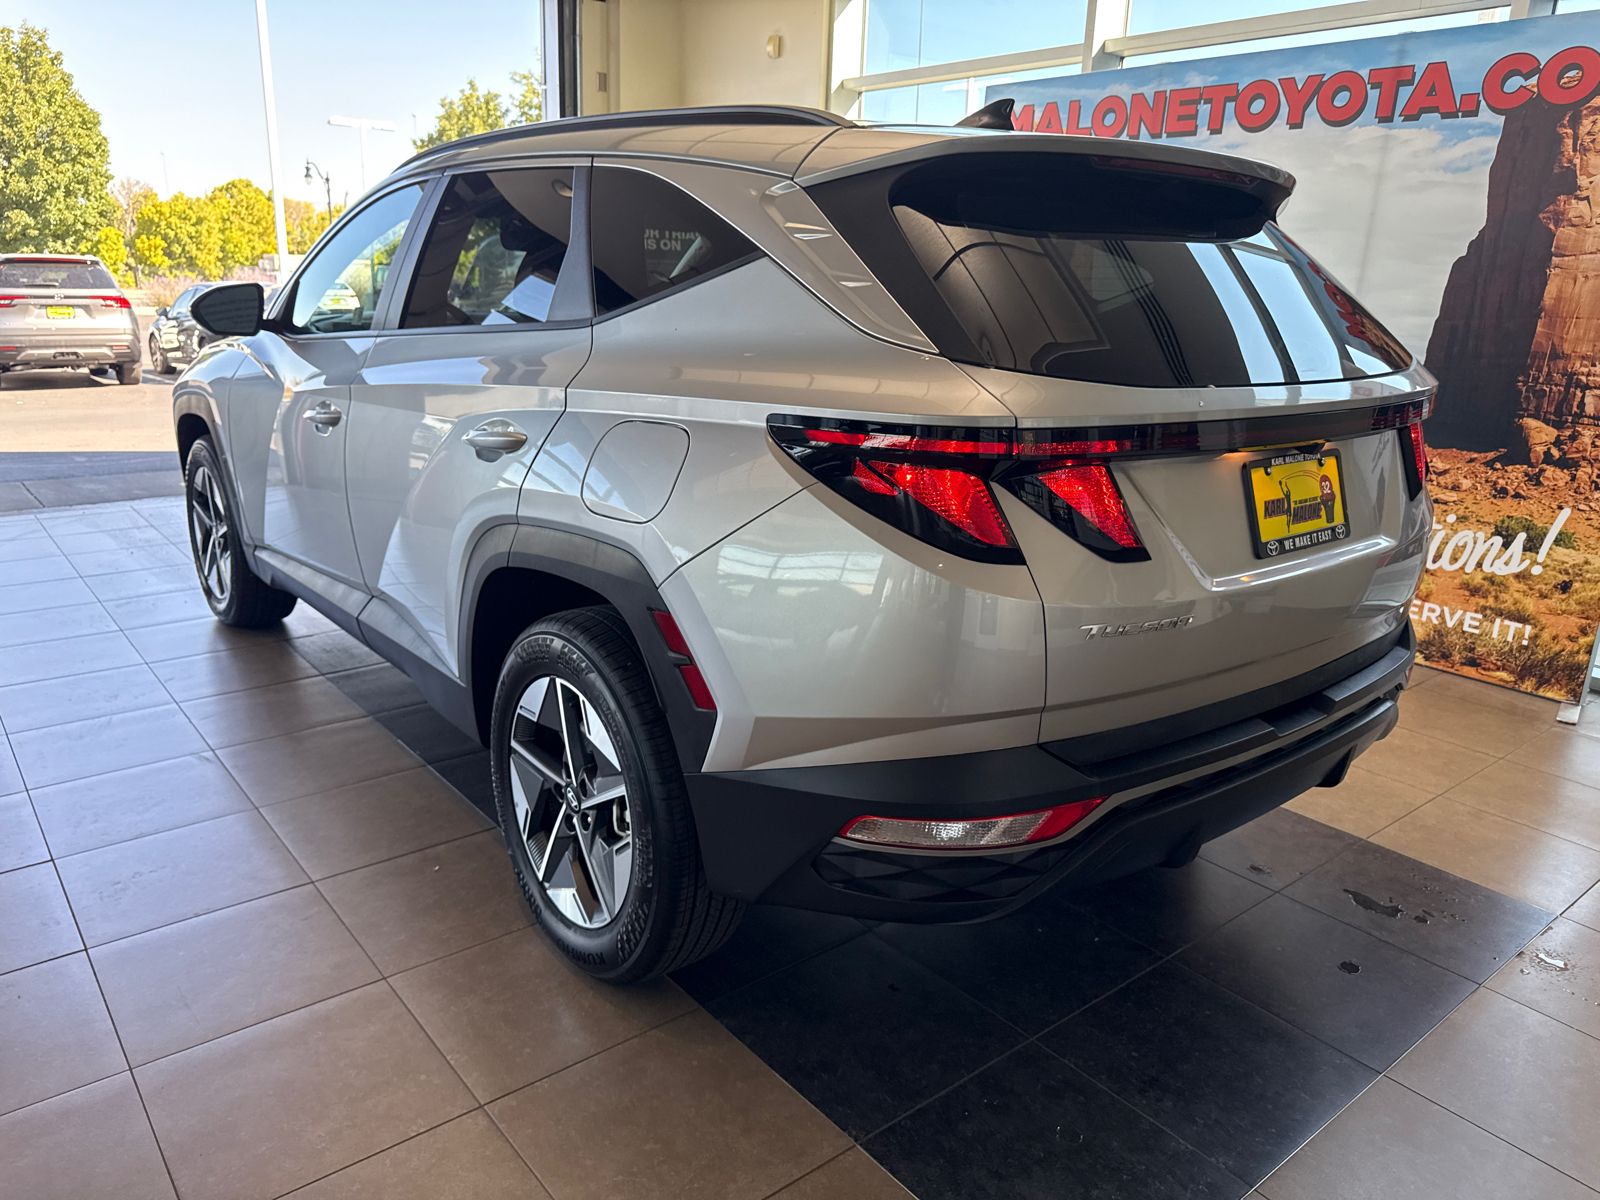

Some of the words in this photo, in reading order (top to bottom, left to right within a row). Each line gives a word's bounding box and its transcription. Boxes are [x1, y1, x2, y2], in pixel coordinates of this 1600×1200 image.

[660, 240, 681, 251] ON
[1321, 481, 1331, 494] 32
[1264, 497, 1286, 519] KARL
[1284, 540, 1294, 551] WE
[1295, 534, 1311, 547] MAKE
[1311, 532, 1318, 544] IT
[1318, 529, 1332, 542] EASY
[1426, 507, 1571, 575] ions!
[1078, 613, 1194, 640] TUCSON
[1491, 618, 1532, 646] IT!
